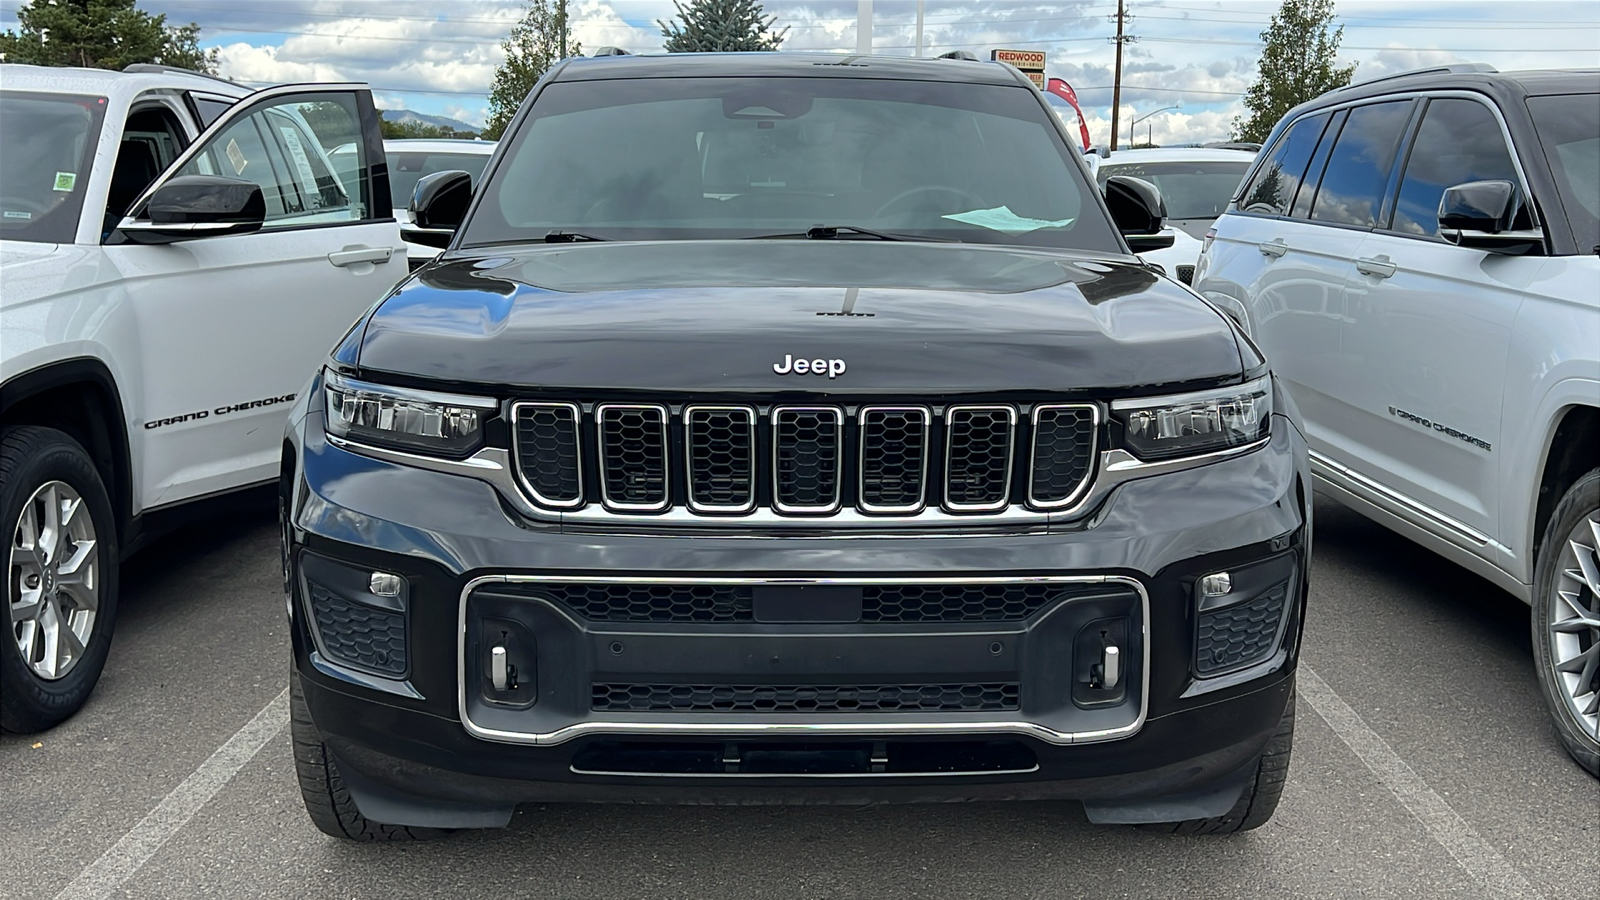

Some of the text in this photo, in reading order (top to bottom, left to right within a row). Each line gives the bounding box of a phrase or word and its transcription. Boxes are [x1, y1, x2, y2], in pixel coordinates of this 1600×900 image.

[998, 52, 1043, 62] REDWOOD
[773, 353, 846, 379] Jeep
[144, 393, 297, 430] GRAND CHEROKE
[1396, 409, 1491, 451] GRAND CHEROKEE
